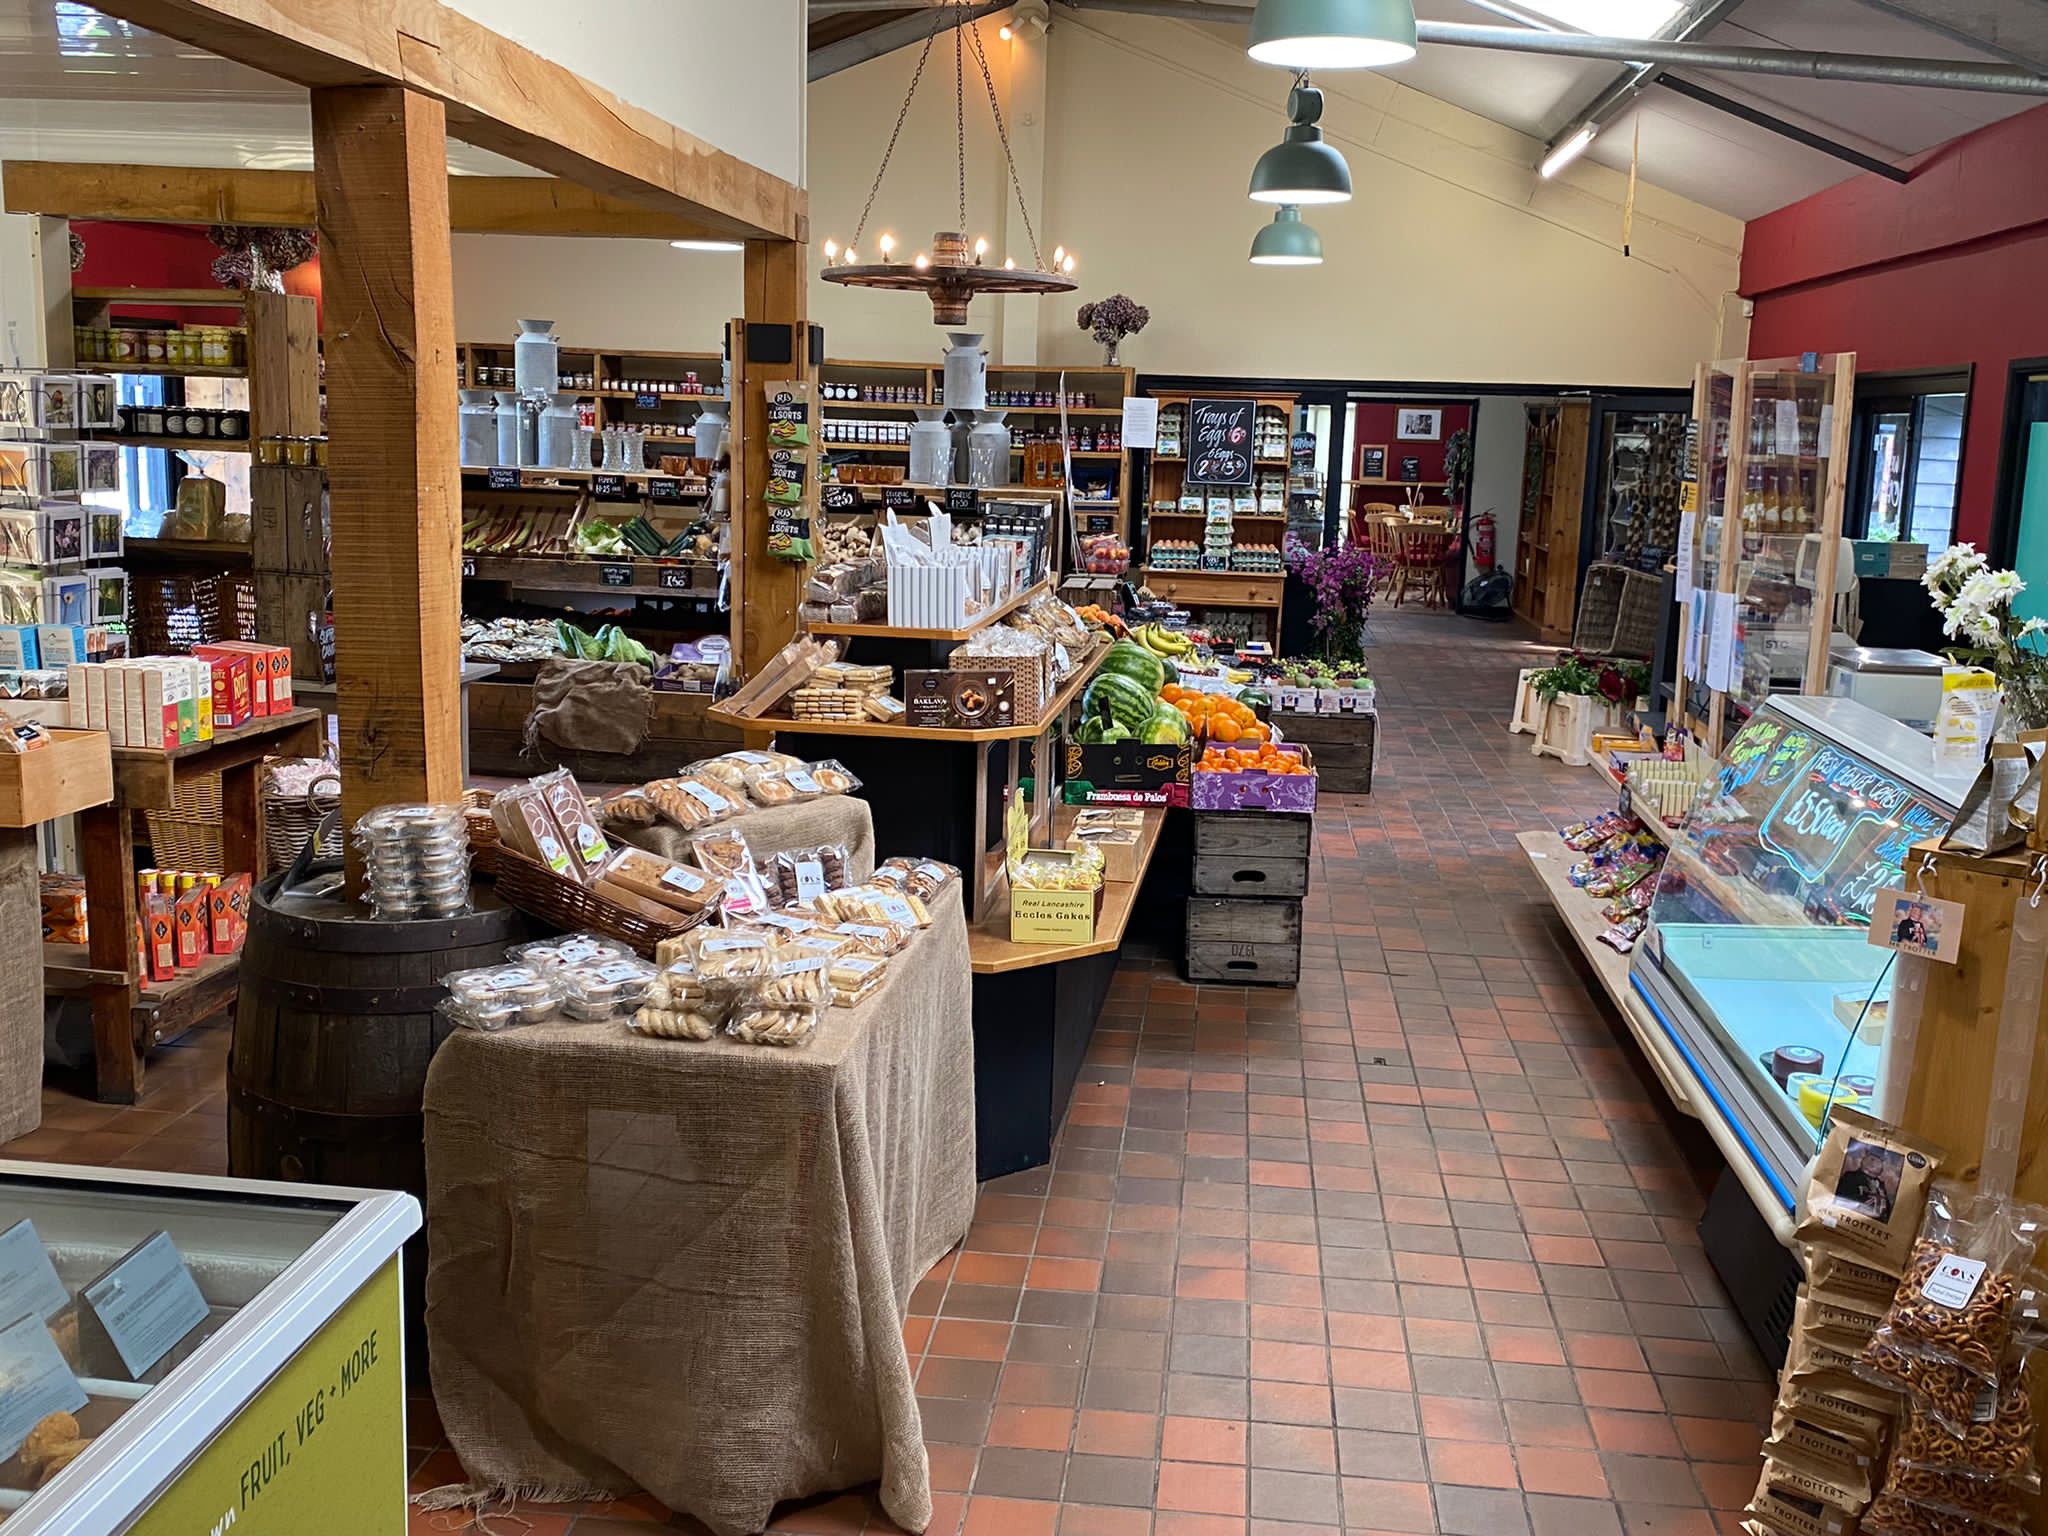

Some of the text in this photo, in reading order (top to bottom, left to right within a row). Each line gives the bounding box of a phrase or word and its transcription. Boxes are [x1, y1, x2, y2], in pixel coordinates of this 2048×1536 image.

[1195, 405, 1245, 429] Trays of
[1198, 426, 1227, 448] Eggs
[1214, 448, 1234, 461] Eggs
[1086, 791, 1132, 801] Frambuesa
[1133, 792, 1143, 801] de
[1022, 899, 1085, 908] Real Lancashire
[1015, 911, 1091, 921] Eccles Cakes
[241, 1431, 291, 1511] FRUIT,
[296, 1389, 325, 1447] VEG
[341, 1329, 378, 1398] MORE
